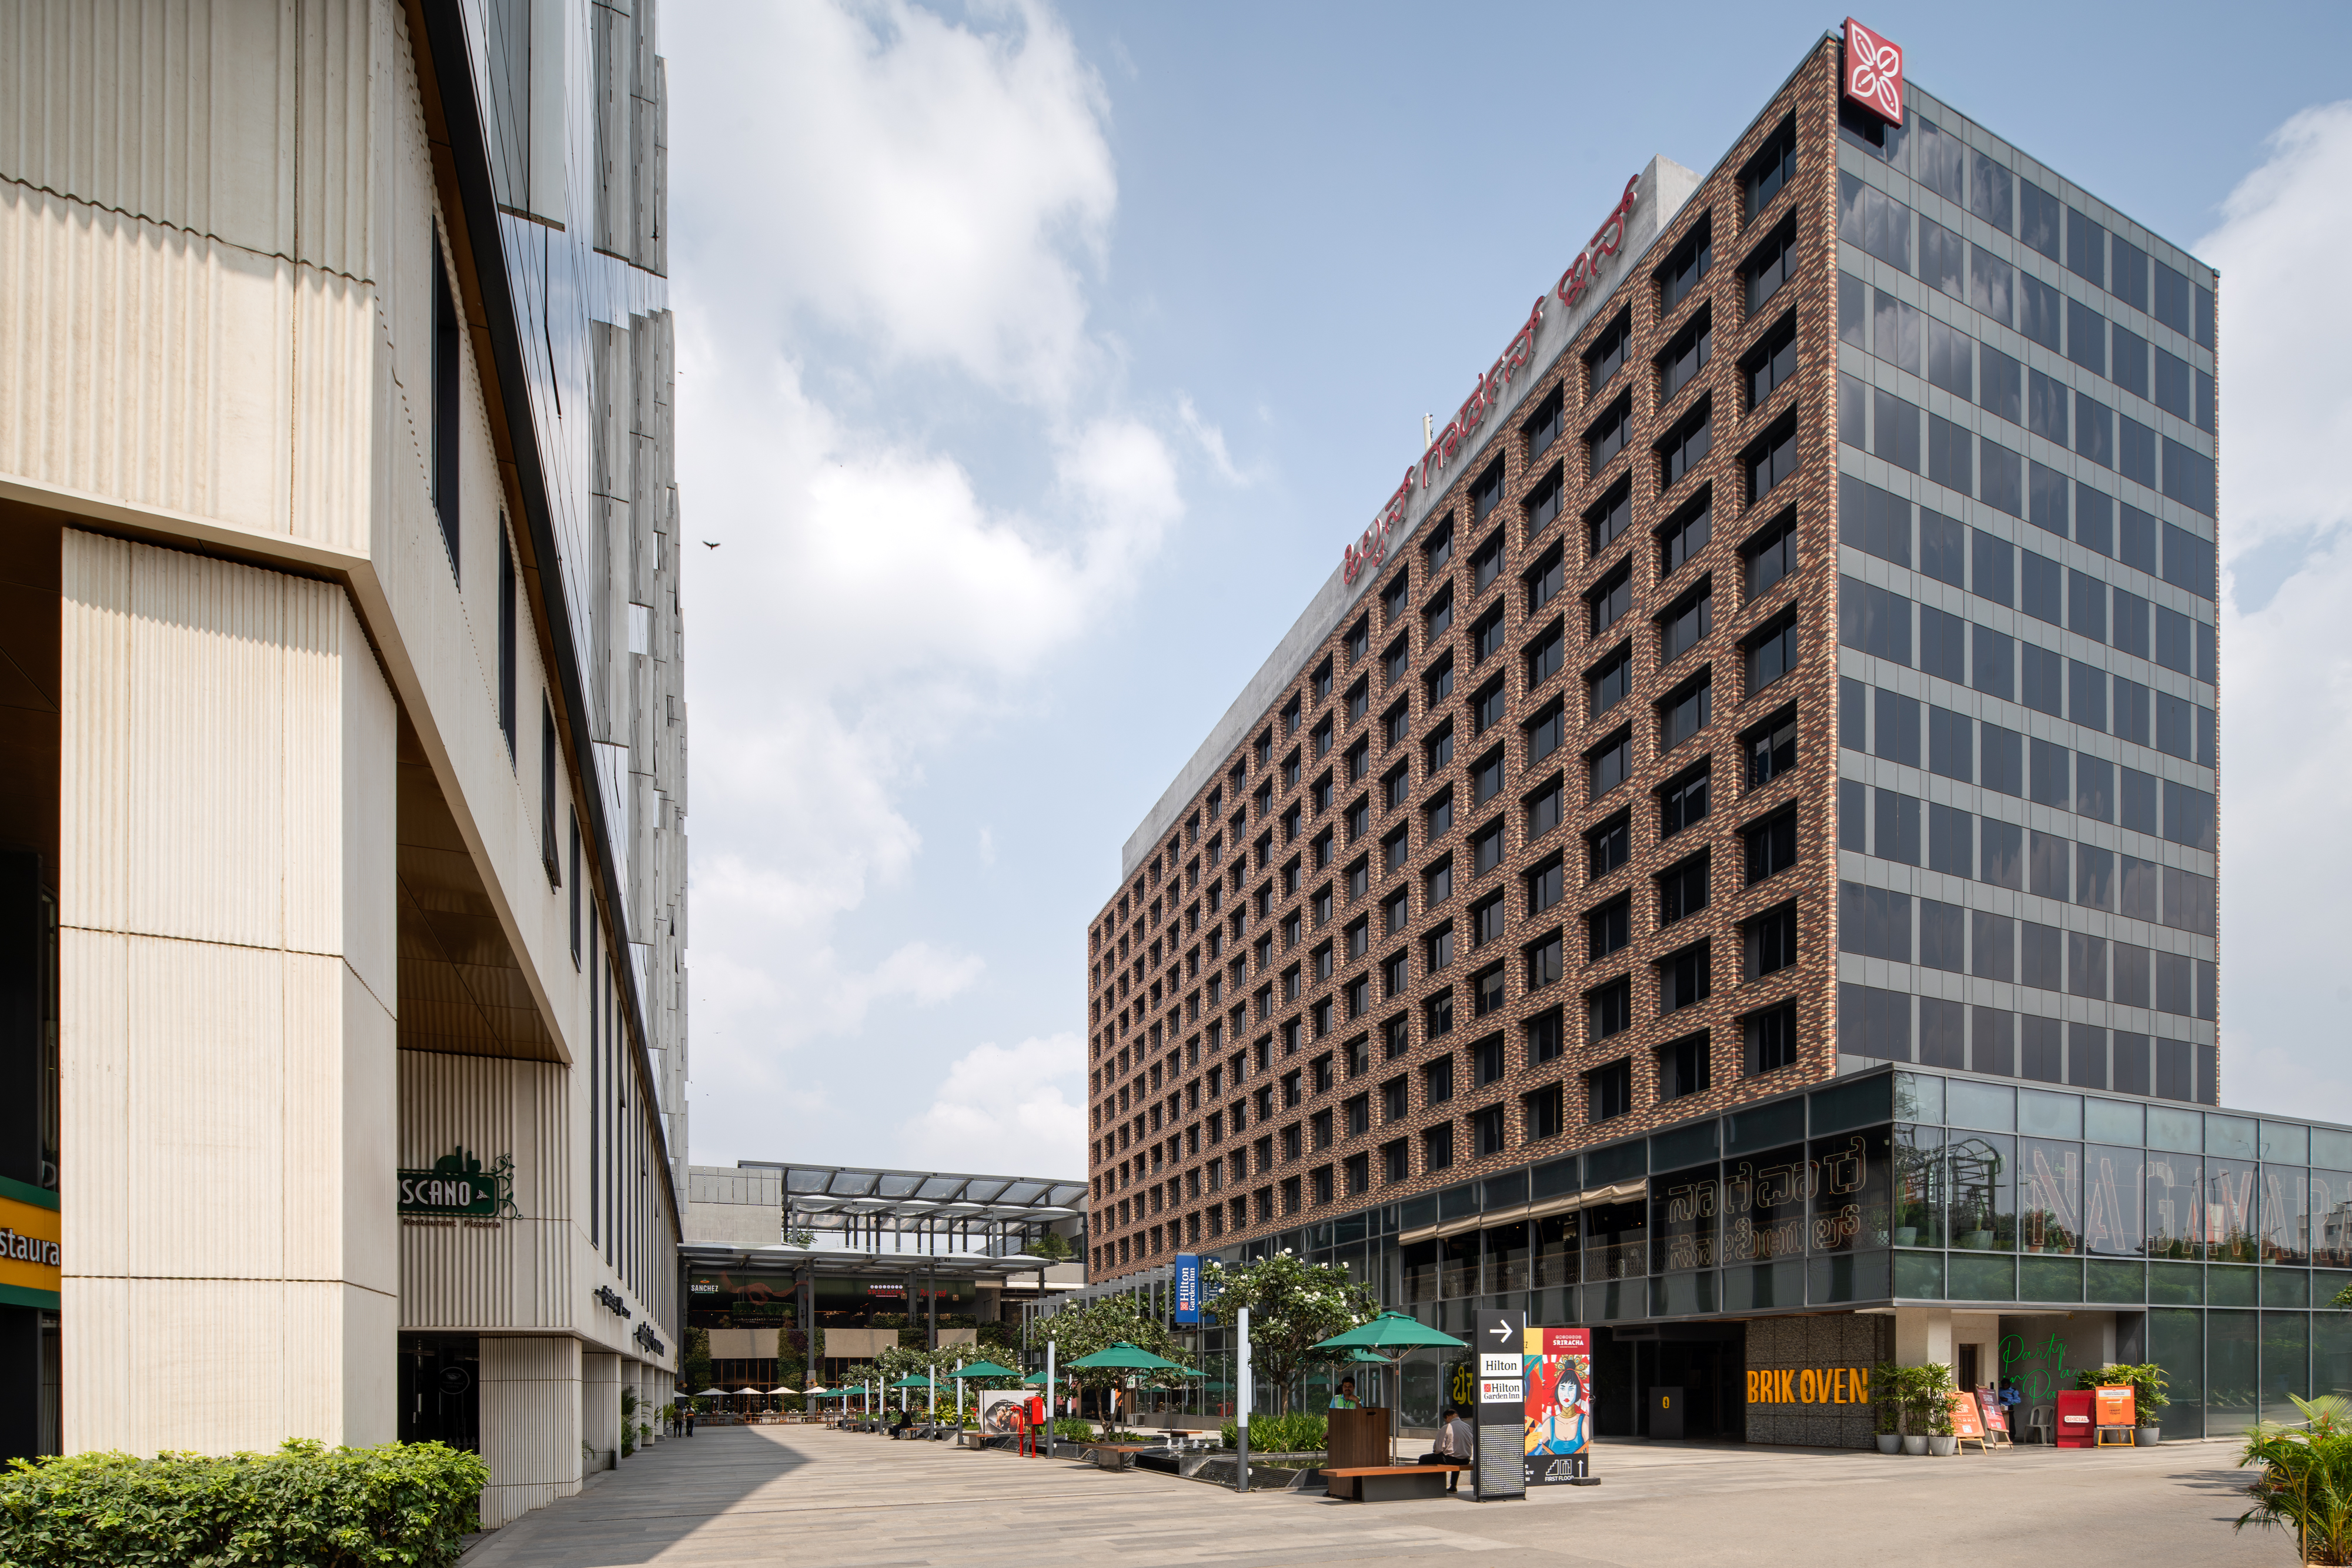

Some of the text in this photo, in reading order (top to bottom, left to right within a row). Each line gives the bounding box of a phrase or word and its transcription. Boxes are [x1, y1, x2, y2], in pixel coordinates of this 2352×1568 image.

[397, 1178, 470, 1206] SCANO
[403, 1218, 501, 1228] Restaurant Pizzeria
[1180, 1268, 1189, 1301] Hilton
[1486, 1360, 1517, 1370] Hilton
[1492, 1383, 1519, 1392] Hilton
[1747, 1368, 1869, 1403] BRIK OVEN
